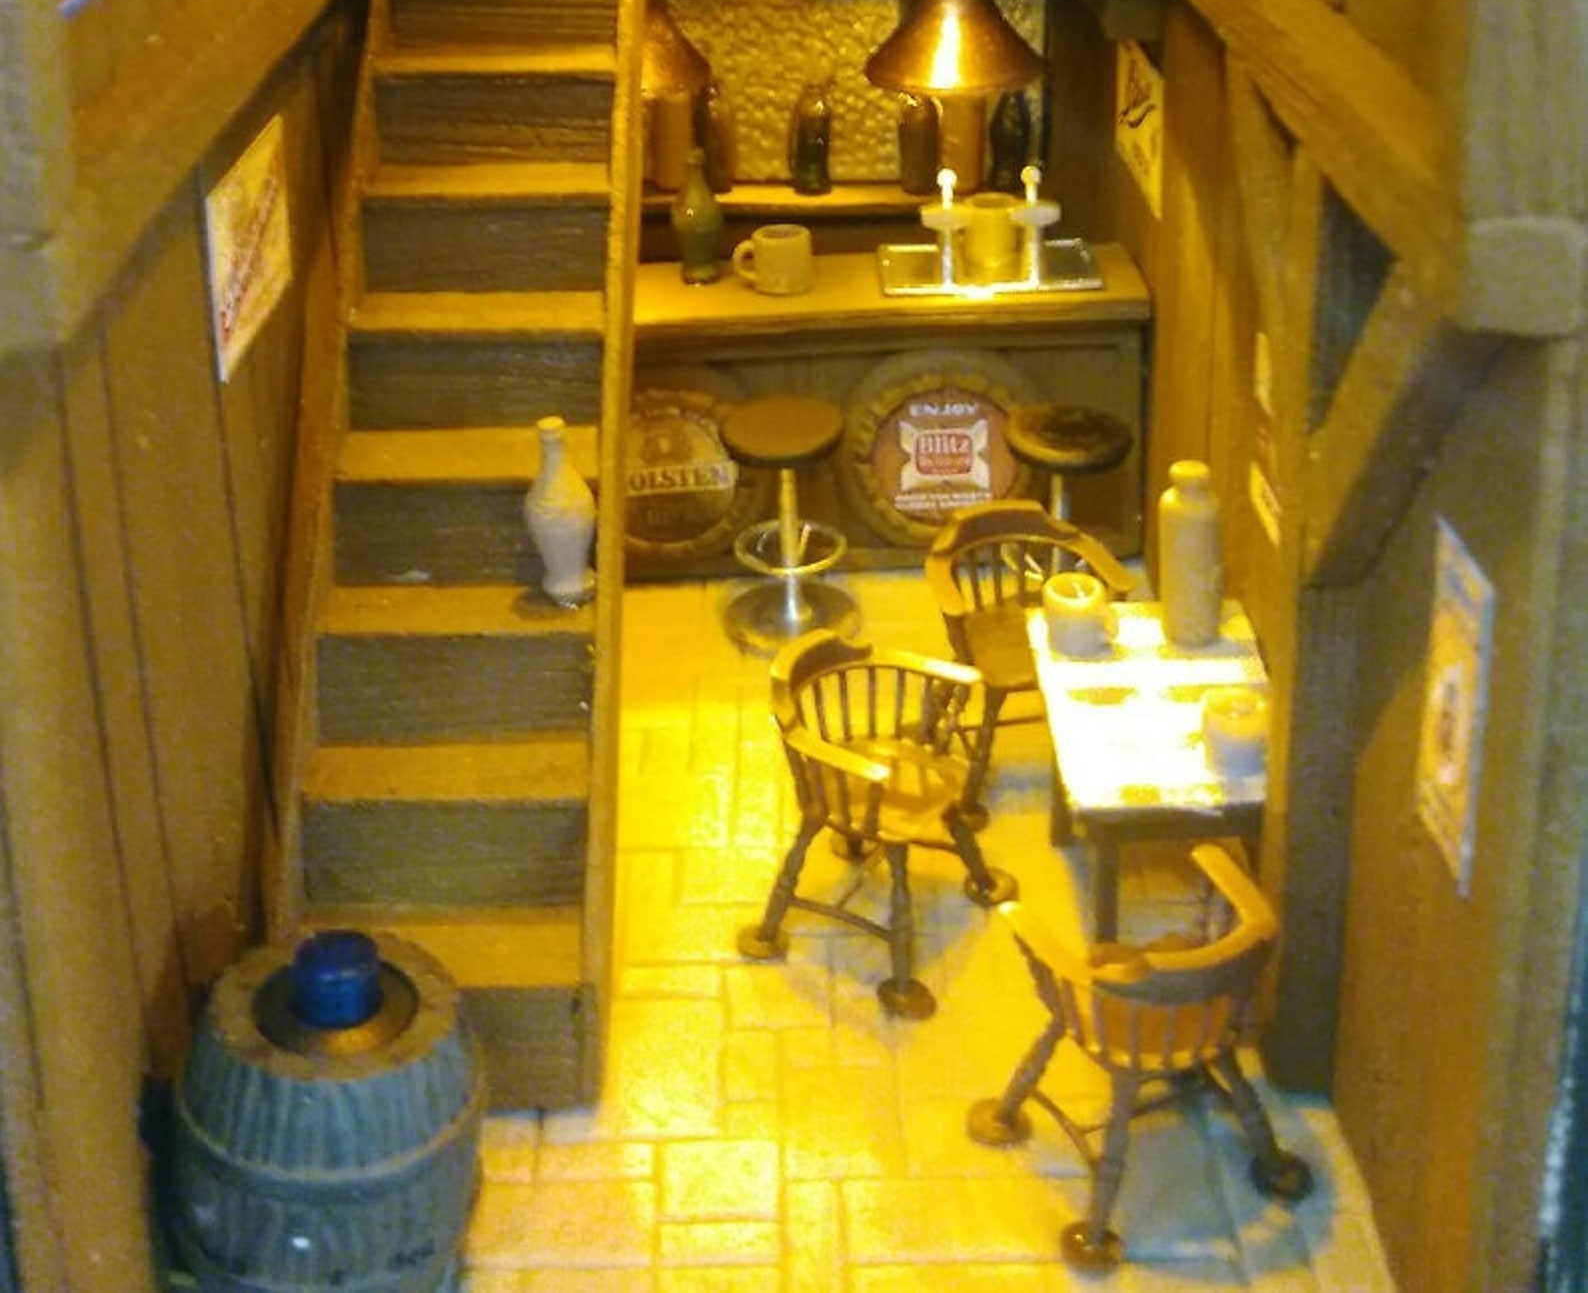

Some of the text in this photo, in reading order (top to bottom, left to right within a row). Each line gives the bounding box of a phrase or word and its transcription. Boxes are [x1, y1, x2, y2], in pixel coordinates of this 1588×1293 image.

[908, 402, 979, 417] ENJOY
[919, 432, 970, 455] Blitz
[629, 465, 731, 491] OLSTEN
